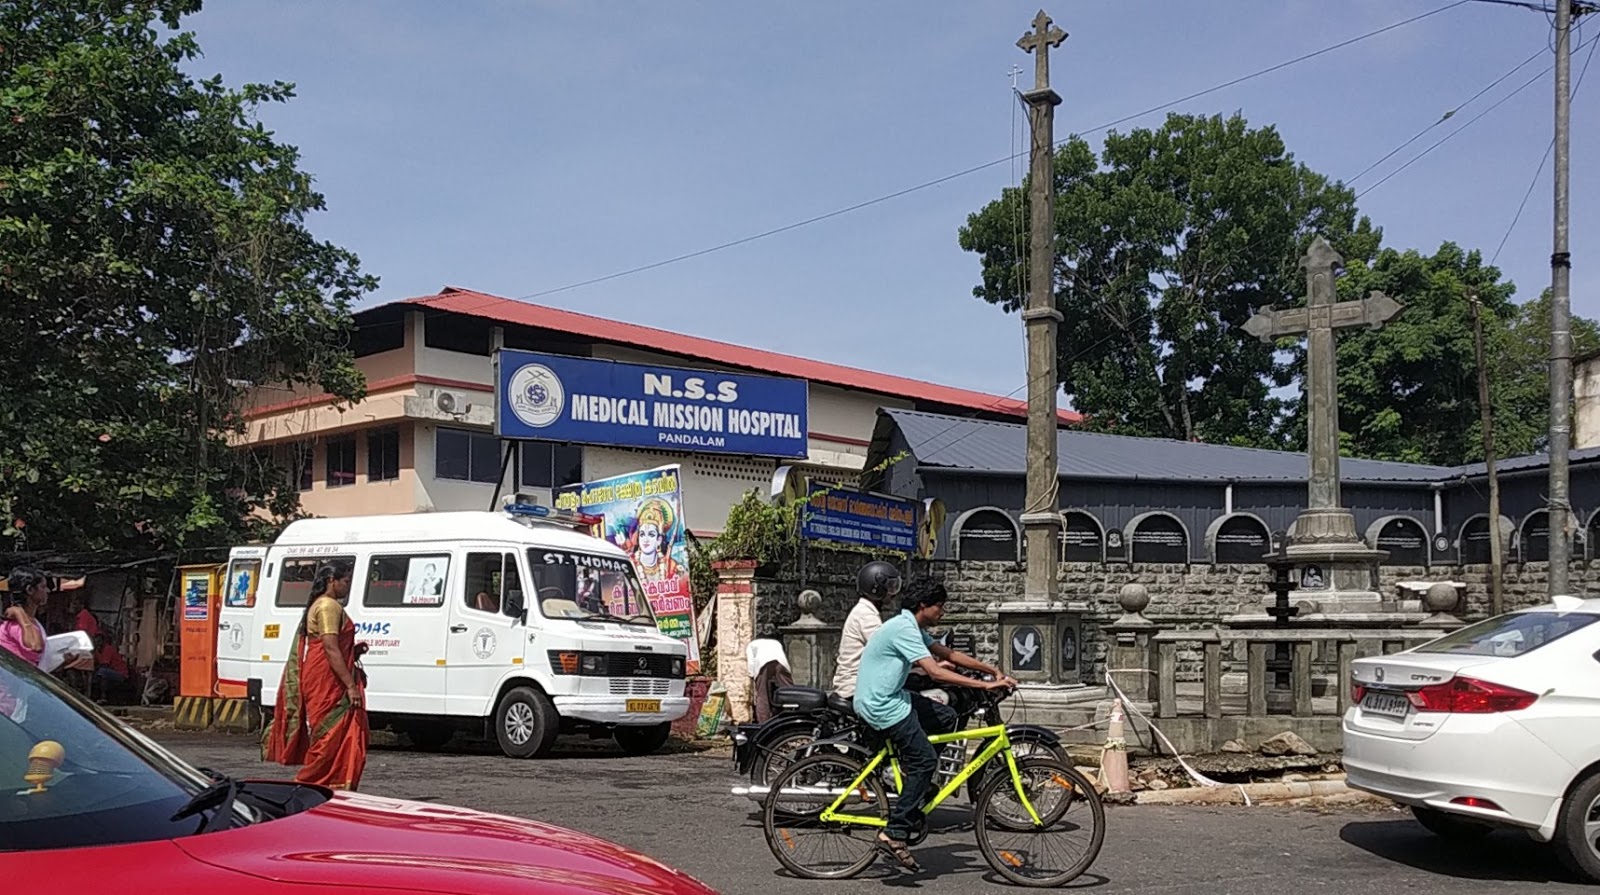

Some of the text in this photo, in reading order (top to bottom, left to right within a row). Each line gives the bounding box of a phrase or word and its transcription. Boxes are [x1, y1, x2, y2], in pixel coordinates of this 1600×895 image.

[644, 373, 738, 403] N.S.S
[571, 394, 801, 439] MEDICAL MISSION HOSPITAL
[658, 432, 725, 448] PANDALAM
[354, 621, 391, 635] OMAS
